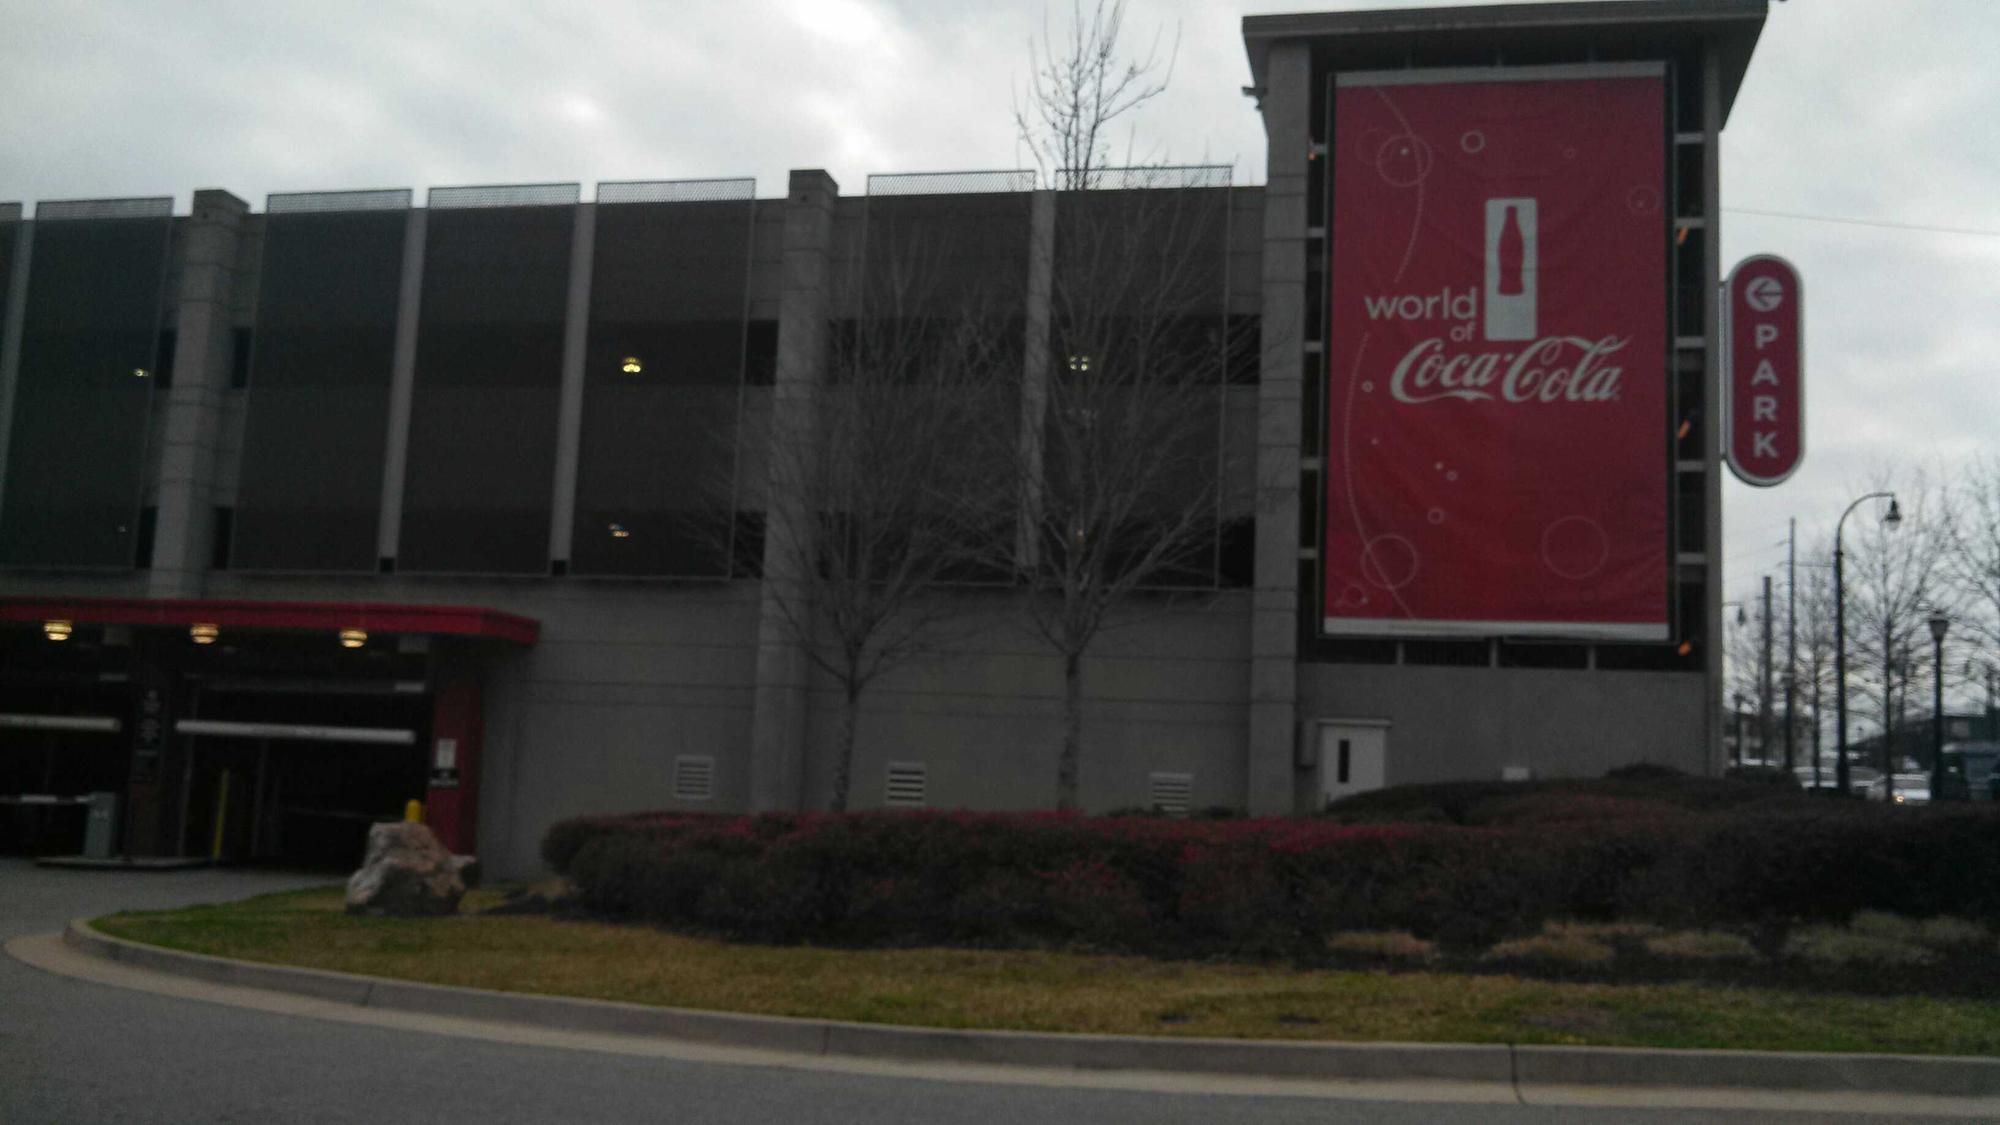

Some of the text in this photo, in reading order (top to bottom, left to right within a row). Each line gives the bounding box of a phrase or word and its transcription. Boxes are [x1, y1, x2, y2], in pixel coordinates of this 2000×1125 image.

[1364, 287, 1477, 321] world
[1451, 321, 1476, 342] of
[1751, 323, 1779, 458] PARK
